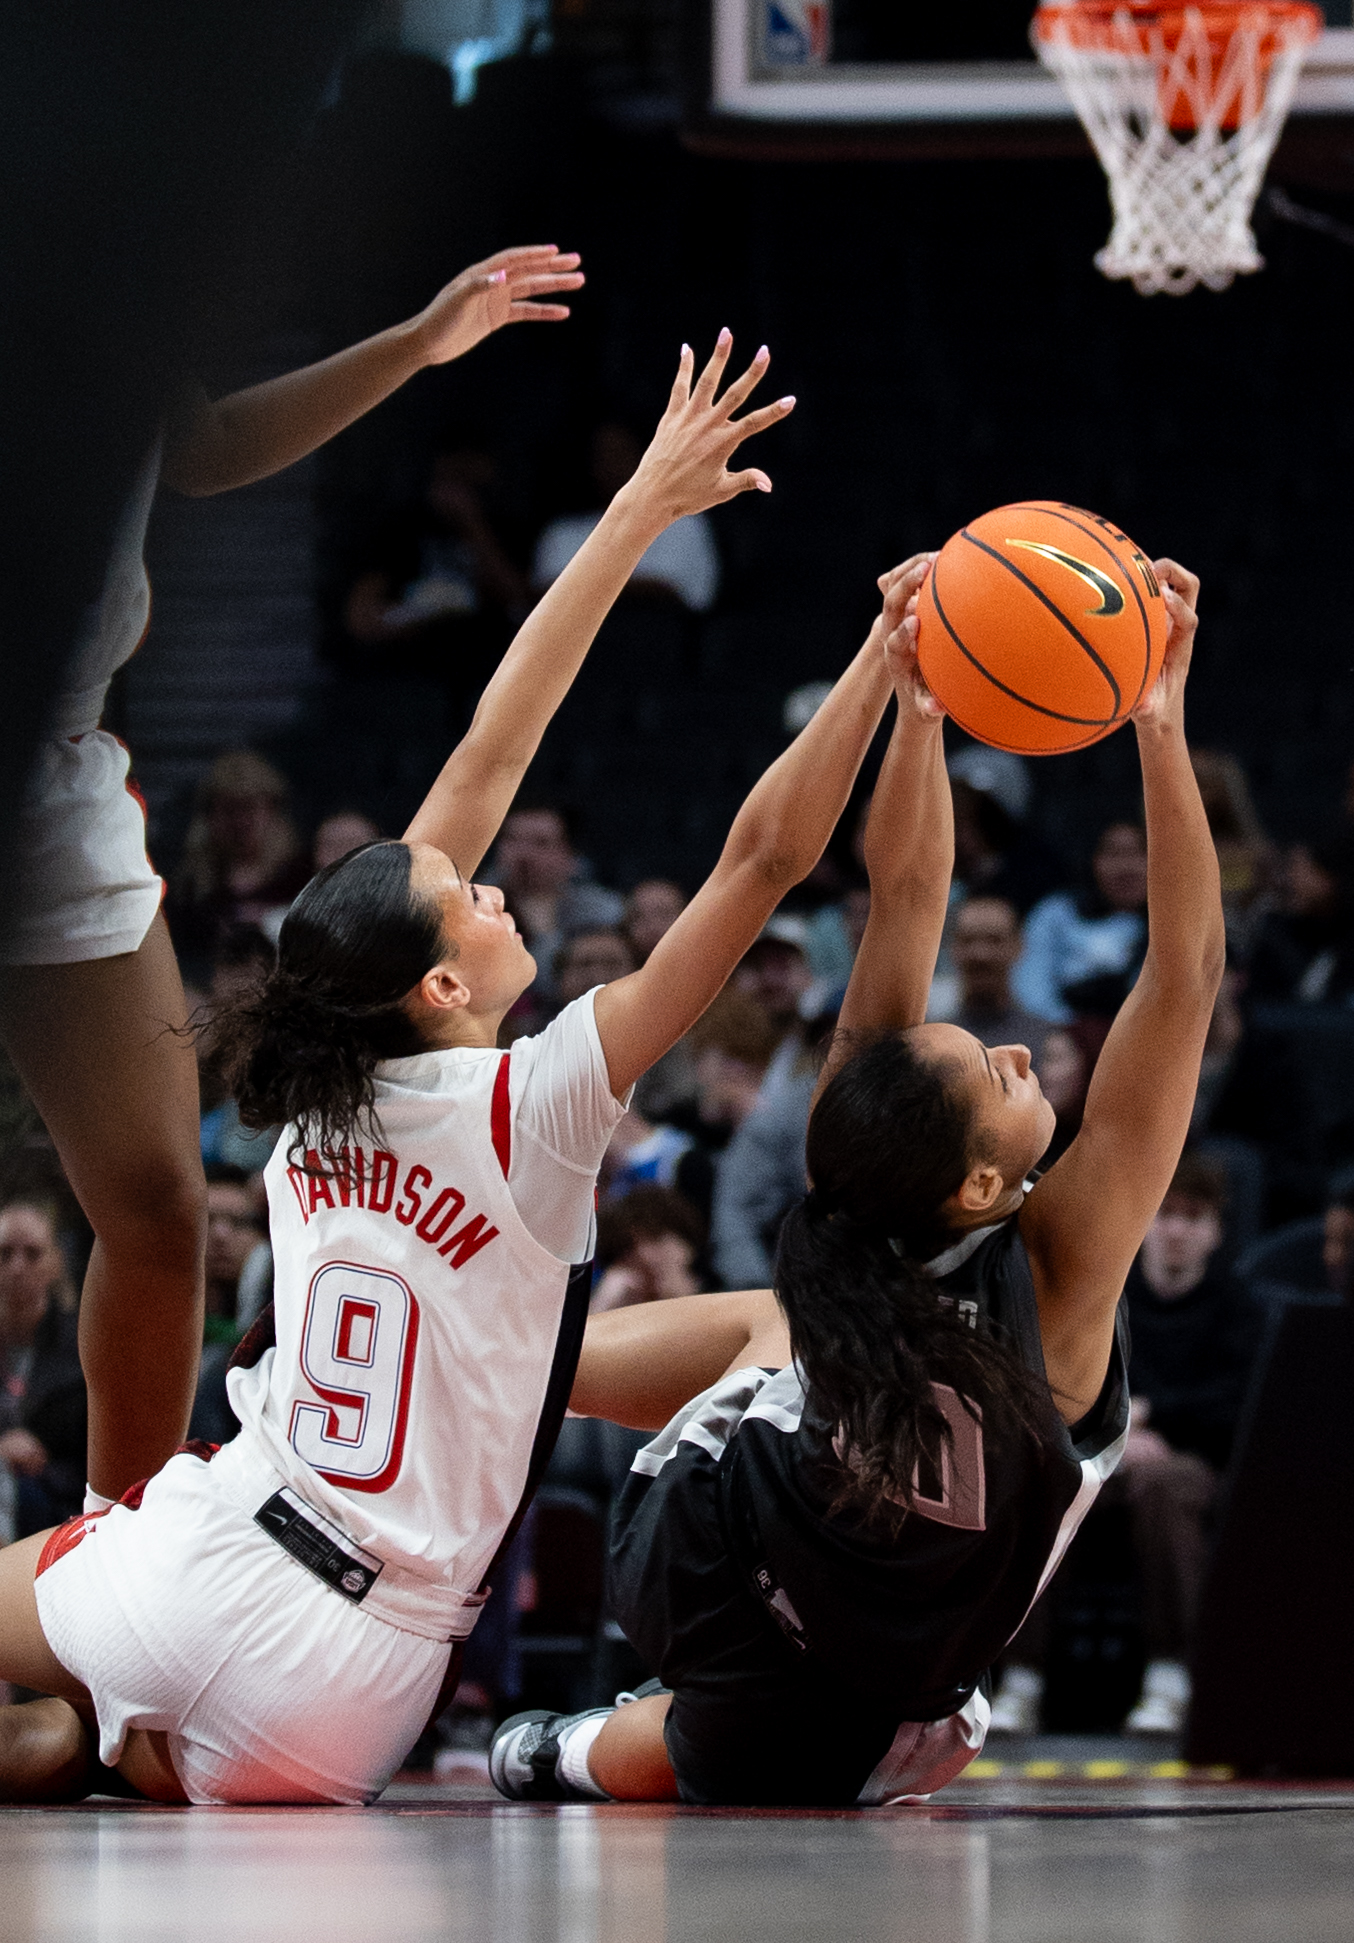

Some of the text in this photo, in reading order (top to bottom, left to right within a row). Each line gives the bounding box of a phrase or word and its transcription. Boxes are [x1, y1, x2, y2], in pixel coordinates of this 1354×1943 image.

[287, 1146, 500, 1270] DAVIDSON
[288, 1260, 420, 1494] 9
[327, 1559, 341, 1572] 30
[757, 1569, 771, 1589] 36
